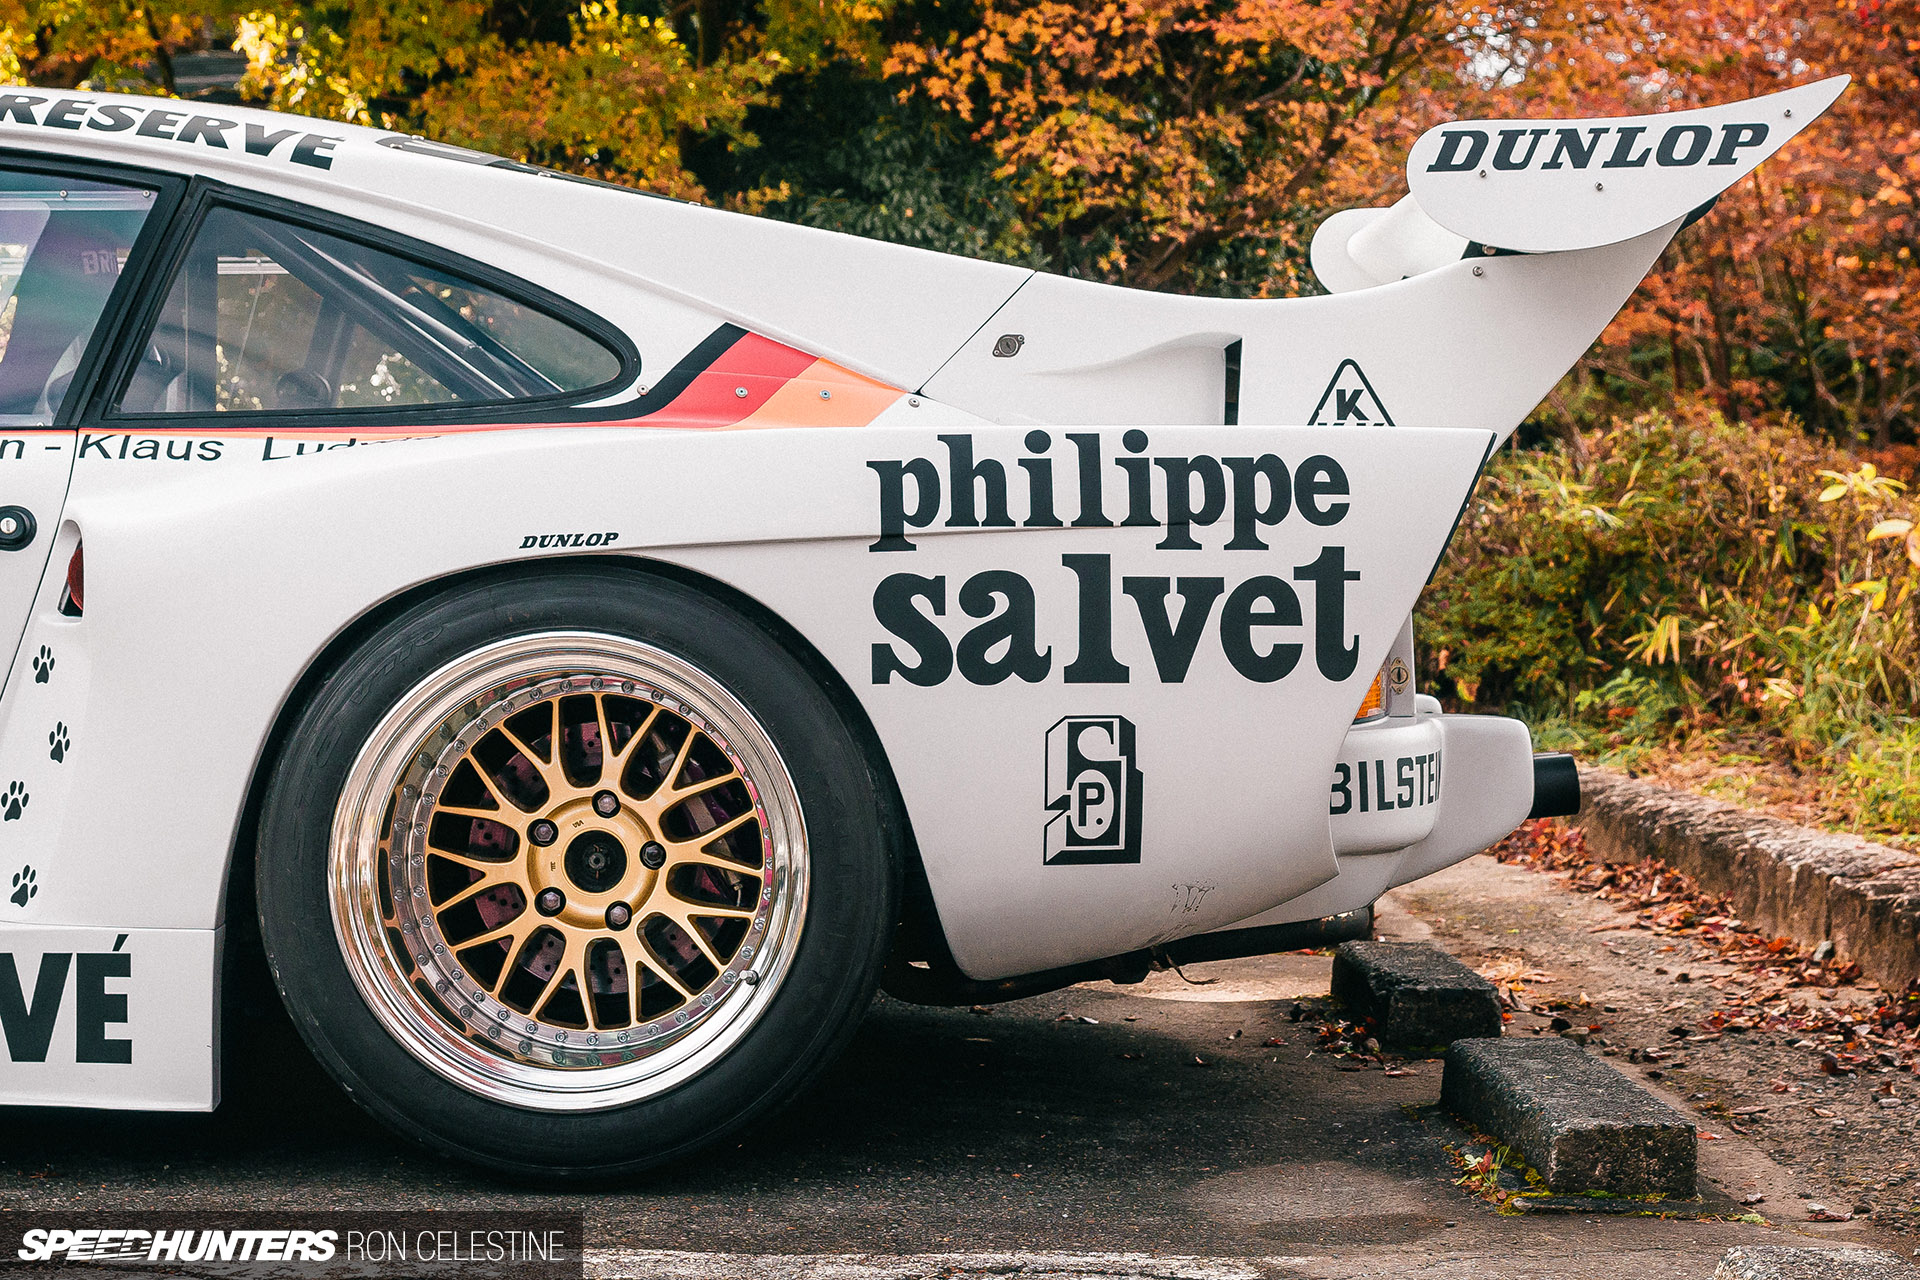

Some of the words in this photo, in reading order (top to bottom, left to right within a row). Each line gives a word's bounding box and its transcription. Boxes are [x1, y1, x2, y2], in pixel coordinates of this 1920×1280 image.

[1427, 123, 1769, 172] DUNLOP
[1336, 389, 1369, 420] K
[78, 434, 224, 461] Klaus
[866, 429, 1351, 552] philippe
[519, 533, 619, 549] DUNLOP
[872, 546, 1361, 687] salvet
[0, 934, 132, 1064] VÉ
